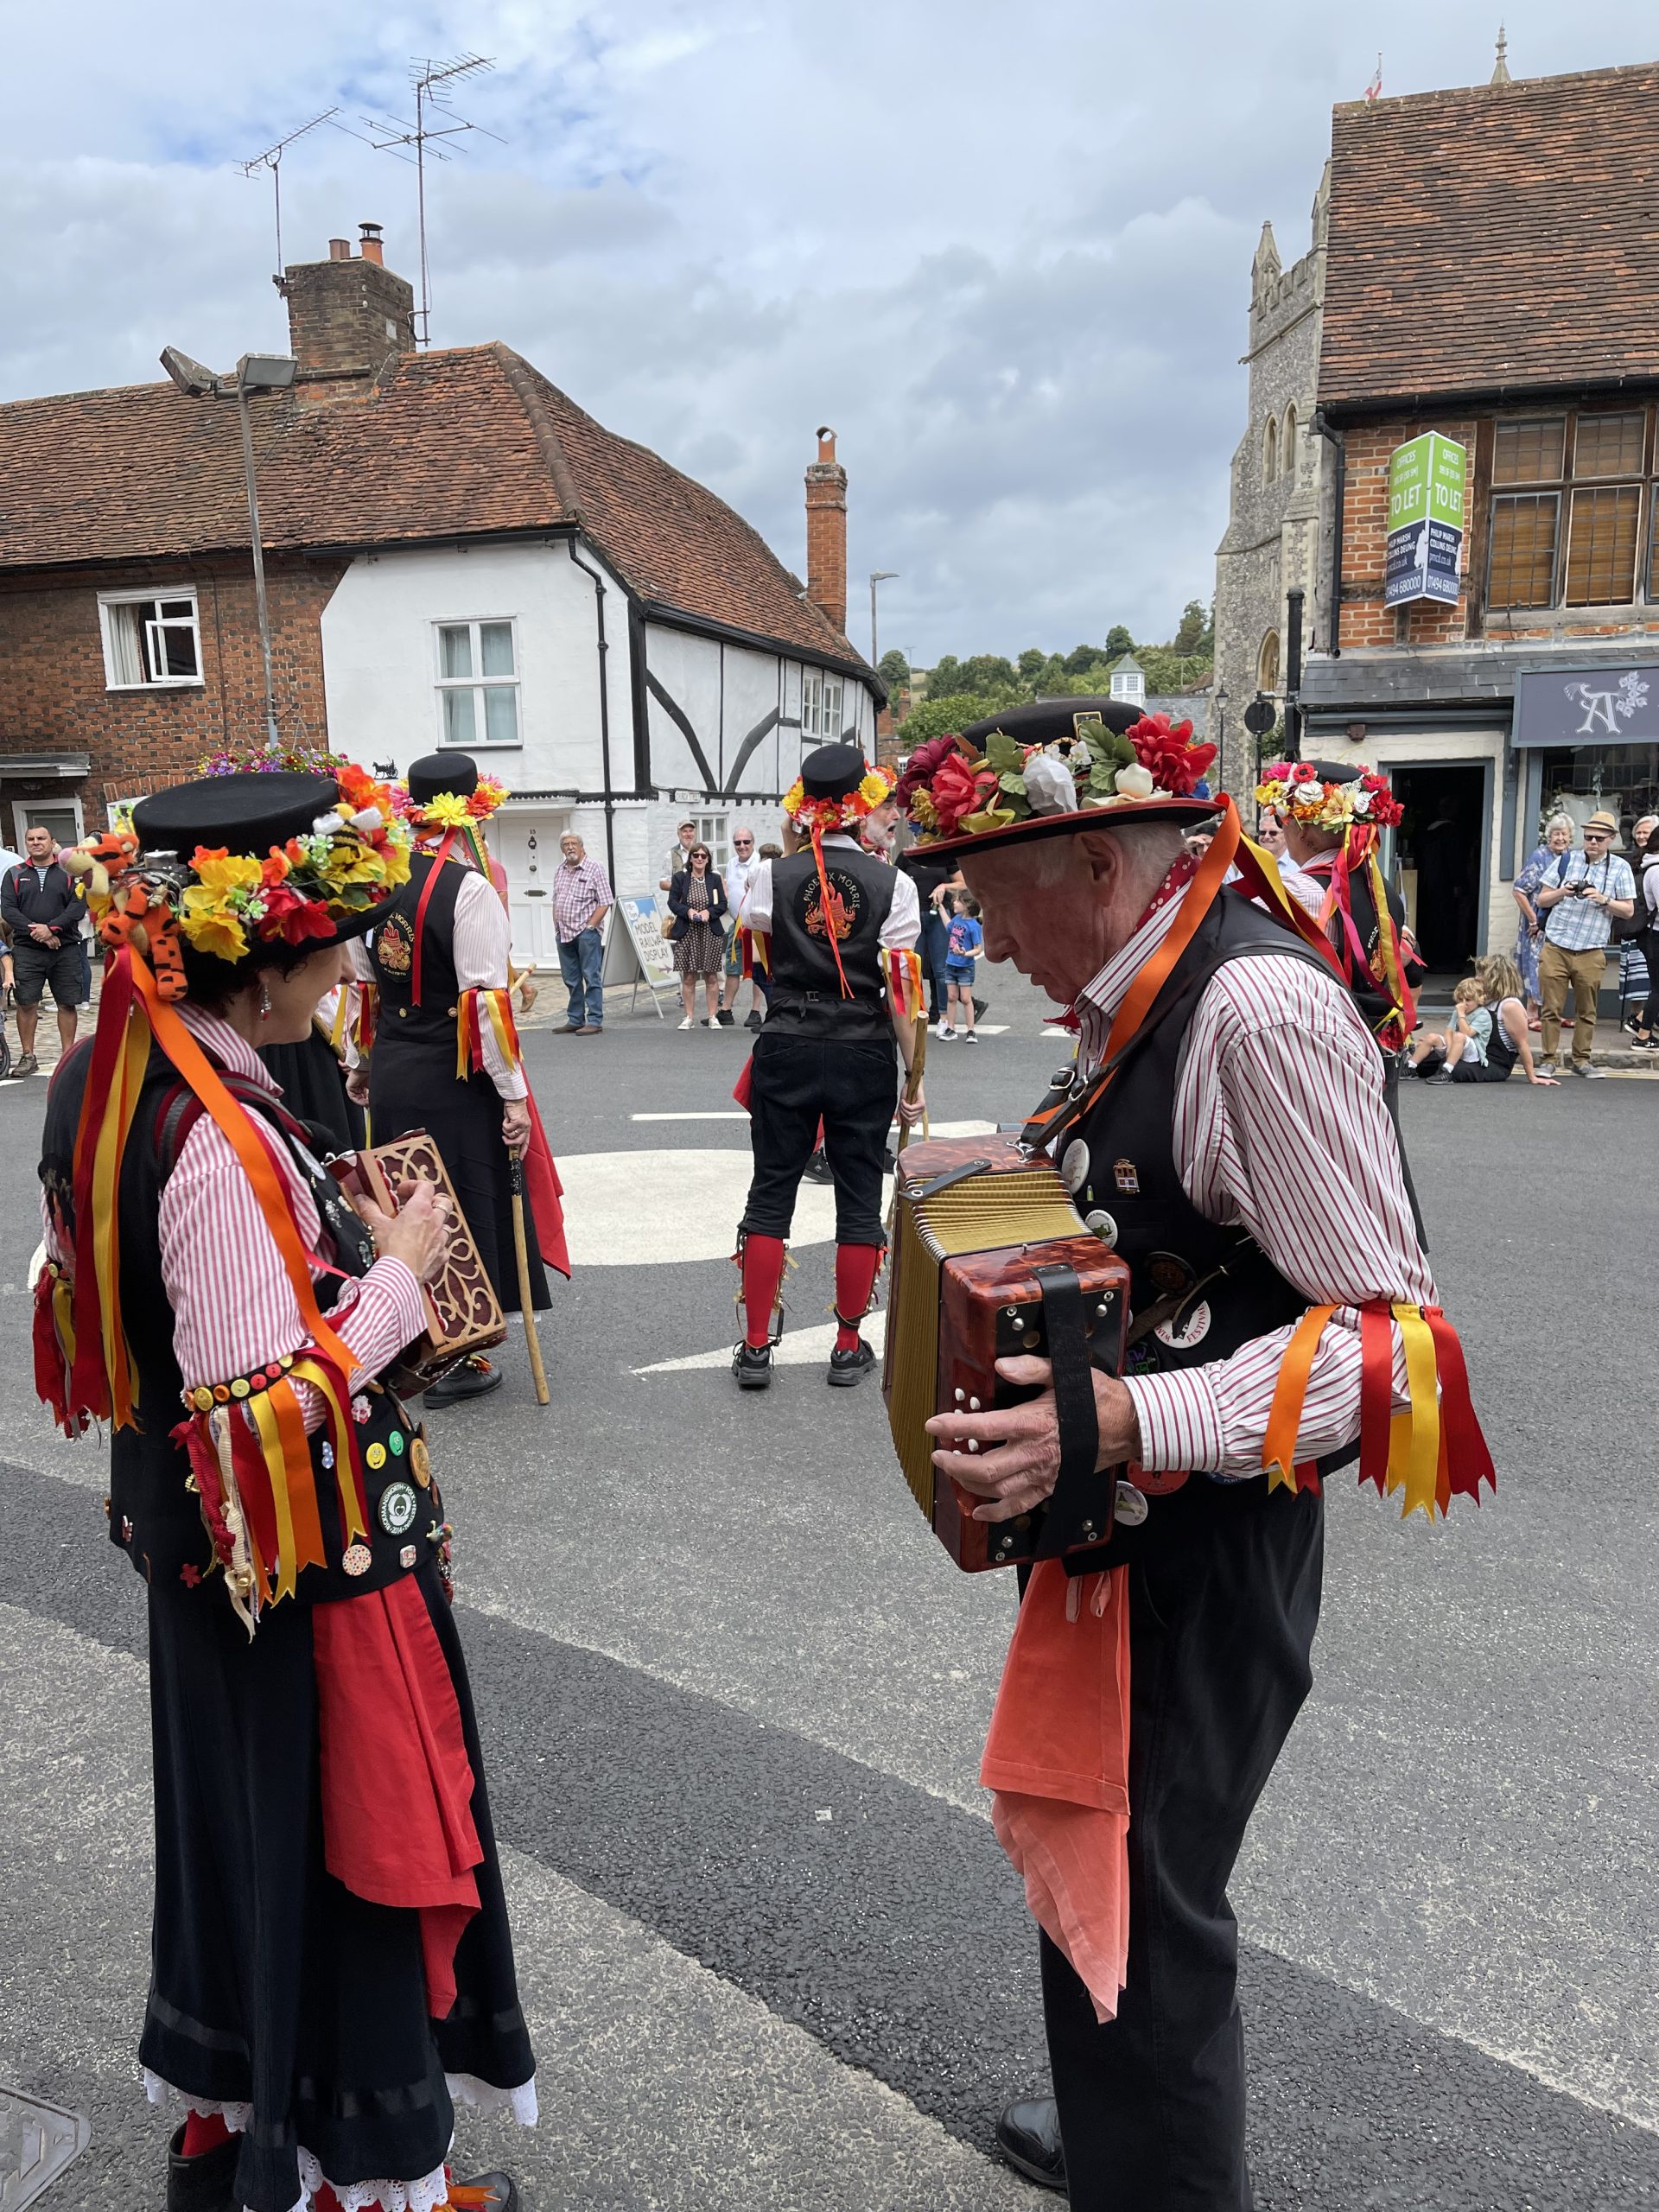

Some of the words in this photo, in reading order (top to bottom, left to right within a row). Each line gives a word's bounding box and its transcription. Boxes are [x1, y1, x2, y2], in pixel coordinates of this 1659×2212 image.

[1390, 493, 1402, 517] TO
[1403, 482, 1422, 511] LET
[1434, 482, 1448, 507] TO
[1449, 487, 1462, 513] LET
[1396, 531, 1412, 546] MARSH
[1431, 527, 1443, 538] PHILIP
[1442, 531, 1455, 543] MARSH
[1429, 538, 1446, 551] COLLINS
[1399, 575, 1421, 594] 680000
[1427, 574, 1442, 592] 01494
[837, 873, 861, 909] MORRIS
[634, 921, 658, 935] MODEL
[643, 947, 669, 962] DISPLAY
[1186, 1305, 1207, 1343] FESTIVAL
[405, 1485, 416, 1501] FOLK
